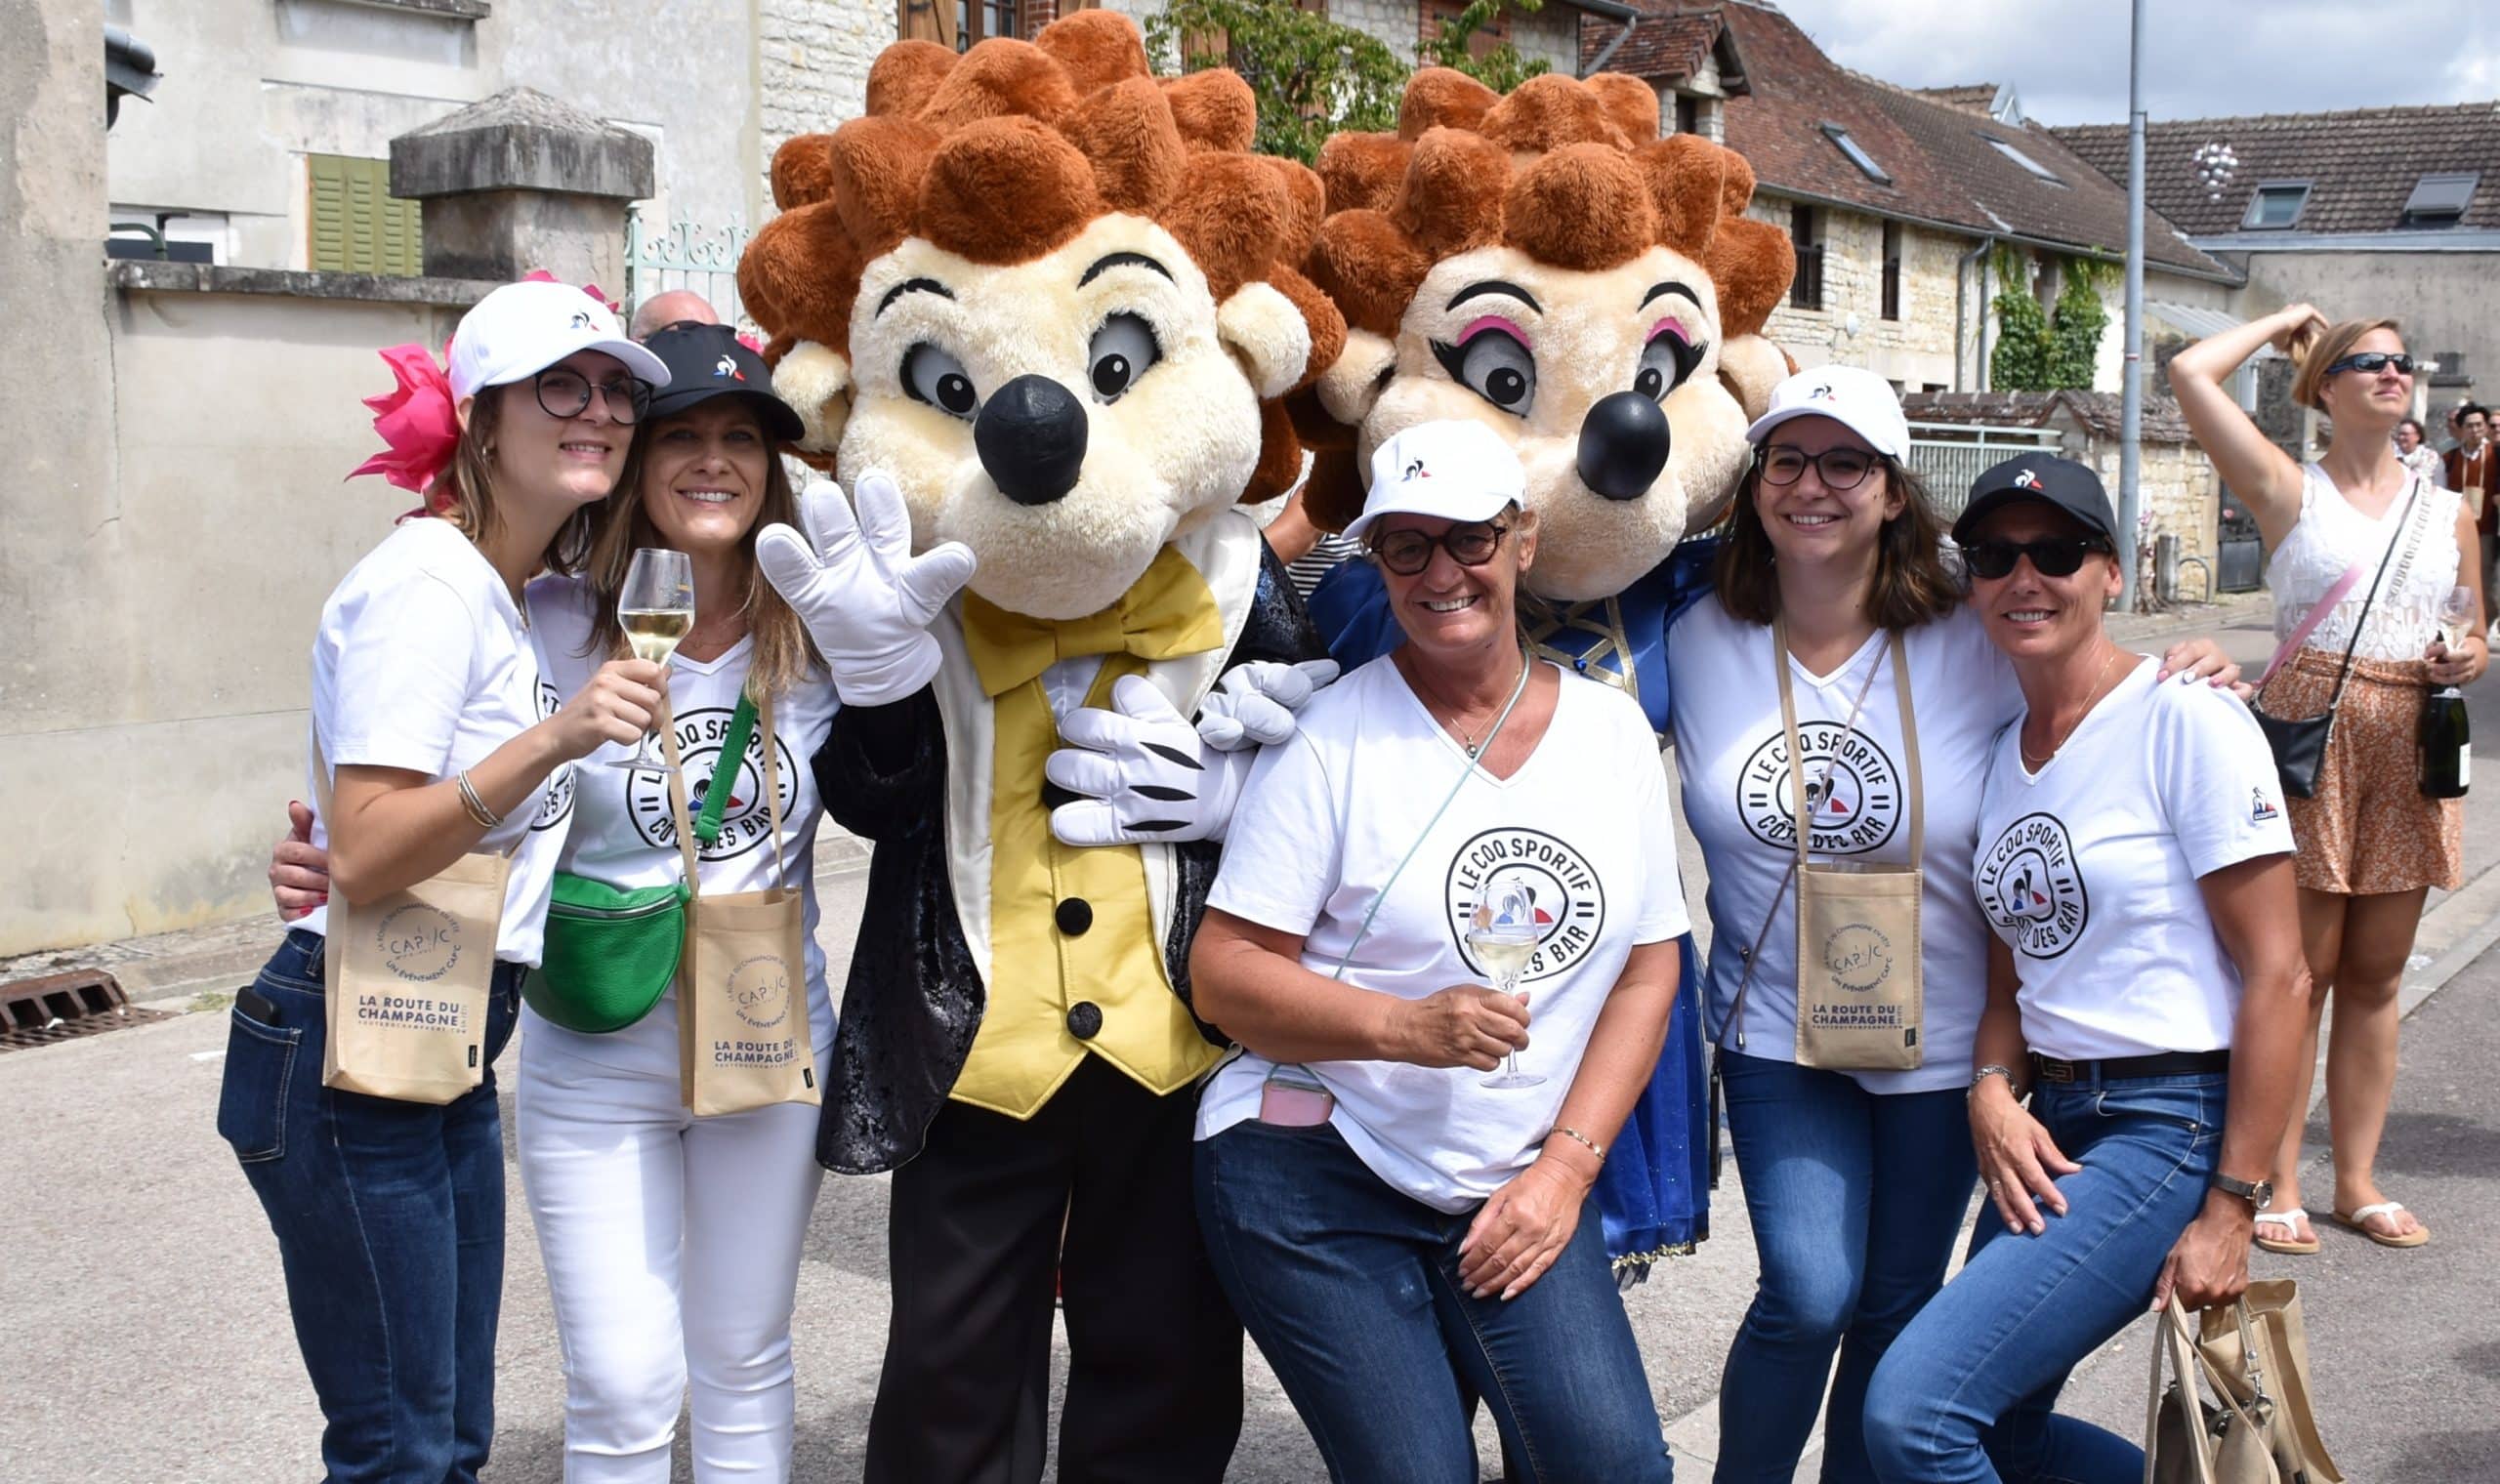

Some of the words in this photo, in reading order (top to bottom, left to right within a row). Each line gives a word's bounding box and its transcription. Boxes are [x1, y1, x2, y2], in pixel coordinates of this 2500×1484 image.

[1752, 760, 1777, 783] LE
[1771, 733, 1812, 763] CQ
[1817, 731, 1887, 786] SPORTIF
[1851, 816, 1886, 845] BAR
[1458, 865, 1480, 890] LE
[1471, 840, 1508, 869] COQ
[1511, 838, 1592, 891] SPORTIF
[1981, 865, 1999, 886] LE
[1997, 829, 2022, 862] COQ
[2025, 823, 2065, 869] SPORTIF
[2032, 926, 2059, 949] DES
[2058, 901, 2079, 934] BAR
[1549, 925, 1589, 964] BAR
[359, 995, 377, 1006] LA
[384, 997, 433, 1010] ROUTE
[438, 1002, 459, 1013] DU
[1812, 1004, 1827, 1013] LA
[1831, 1005, 1872, 1014] ROUTE
[1877, 1005, 1896, 1014] DU
[358, 1008, 458, 1026] CHAMPAGNE
[1812, 1014, 1896, 1024] CHAMPAGNE
[715, 1041, 730, 1051] LA
[736, 1041, 779, 1051] ROUTE
[783, 1039, 793, 1050] DU
[715, 1050, 794, 1063] CHAMPAGNE
